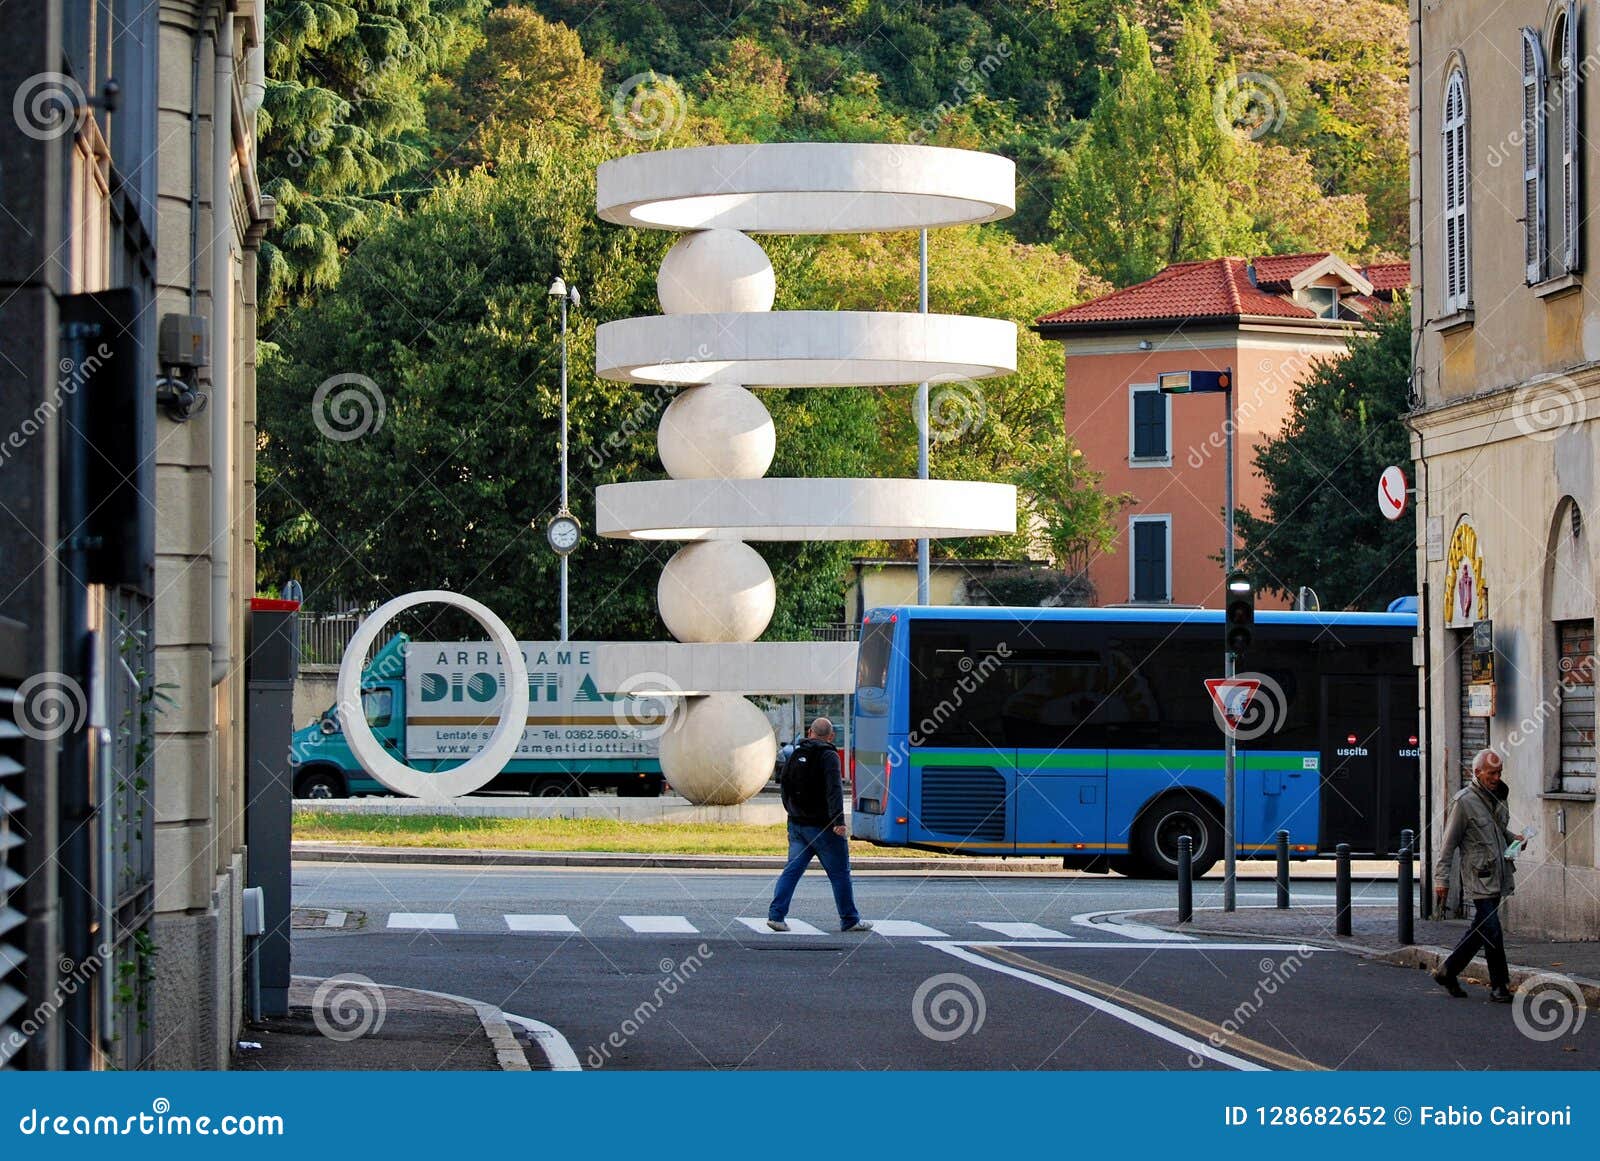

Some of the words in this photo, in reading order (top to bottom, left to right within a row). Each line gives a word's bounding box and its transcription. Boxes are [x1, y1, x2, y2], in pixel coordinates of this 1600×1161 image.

[436, 730, 478, 740] Lentate
[543, 730, 561, 740] Tel.
[1337, 747, 1368, 756] uscita
